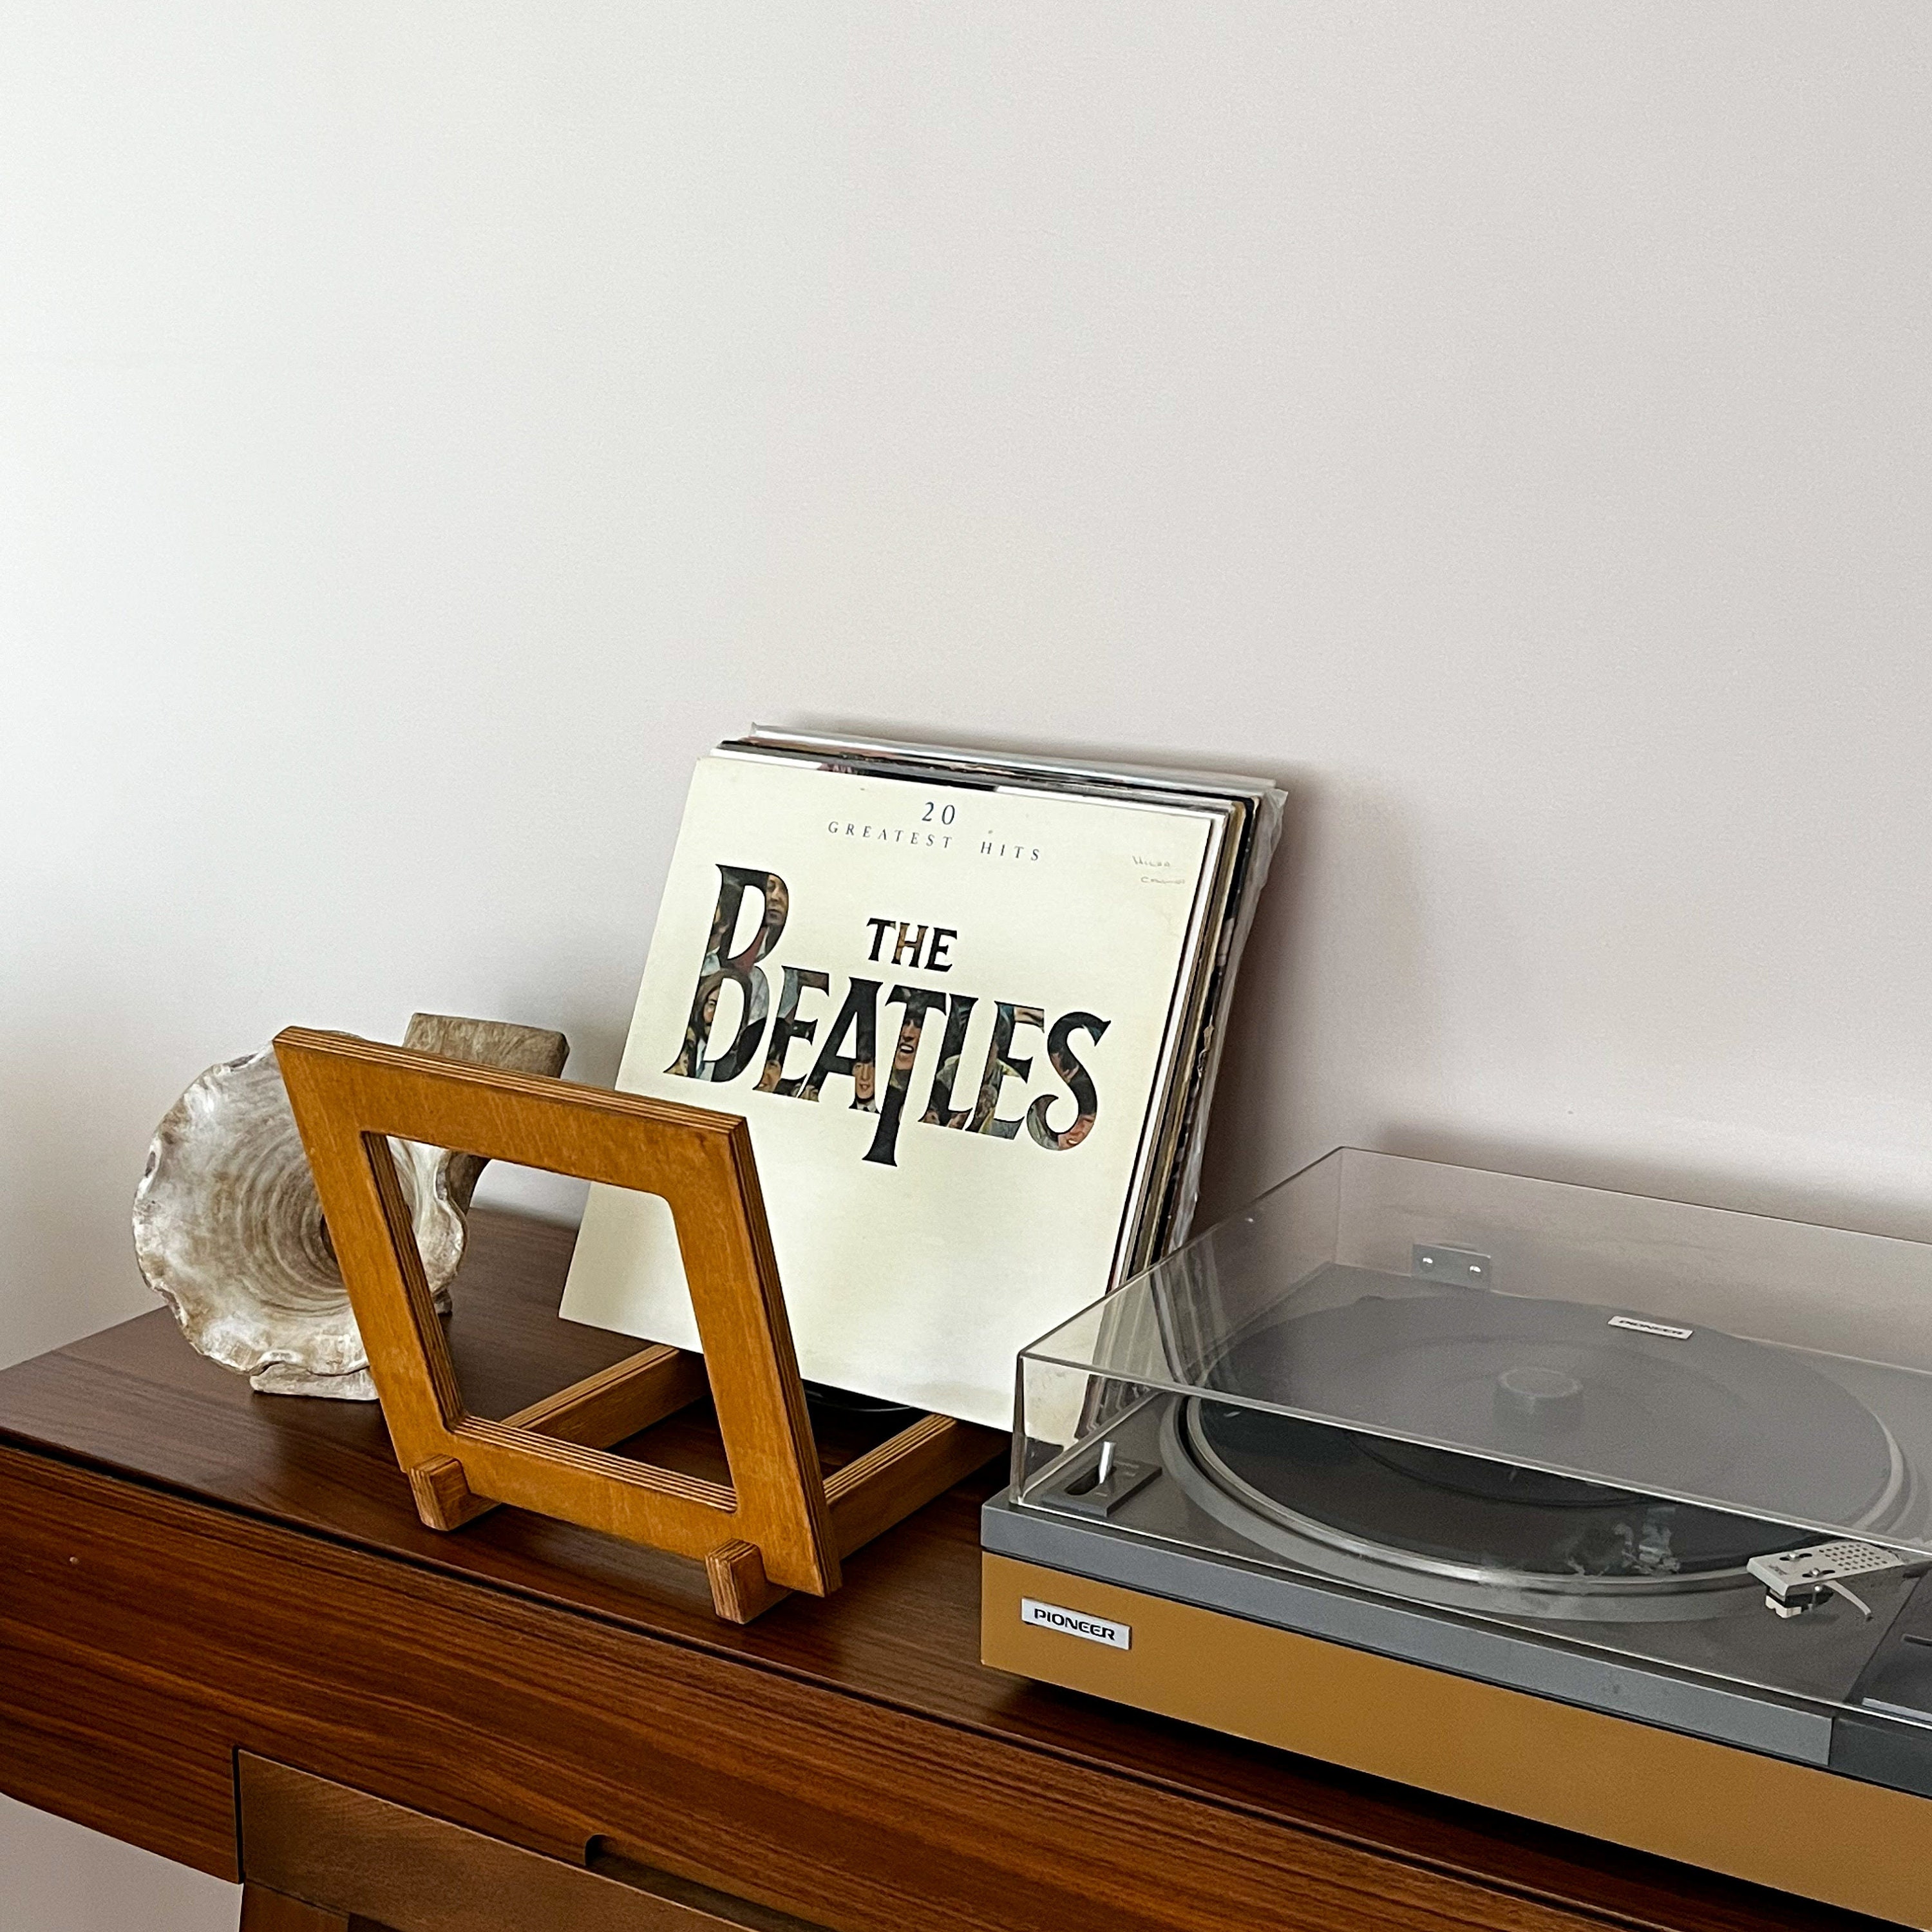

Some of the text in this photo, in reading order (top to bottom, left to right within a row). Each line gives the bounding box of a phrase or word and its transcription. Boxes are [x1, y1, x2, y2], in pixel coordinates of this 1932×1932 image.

[922, 802, 955, 825] 20
[828, 821, 1040, 861] GREATEST HITS
[867, 918, 958, 972] THE
[663, 864, 1112, 1166] BEATLES
[1034, 1608, 1115, 1640] PIONEER
